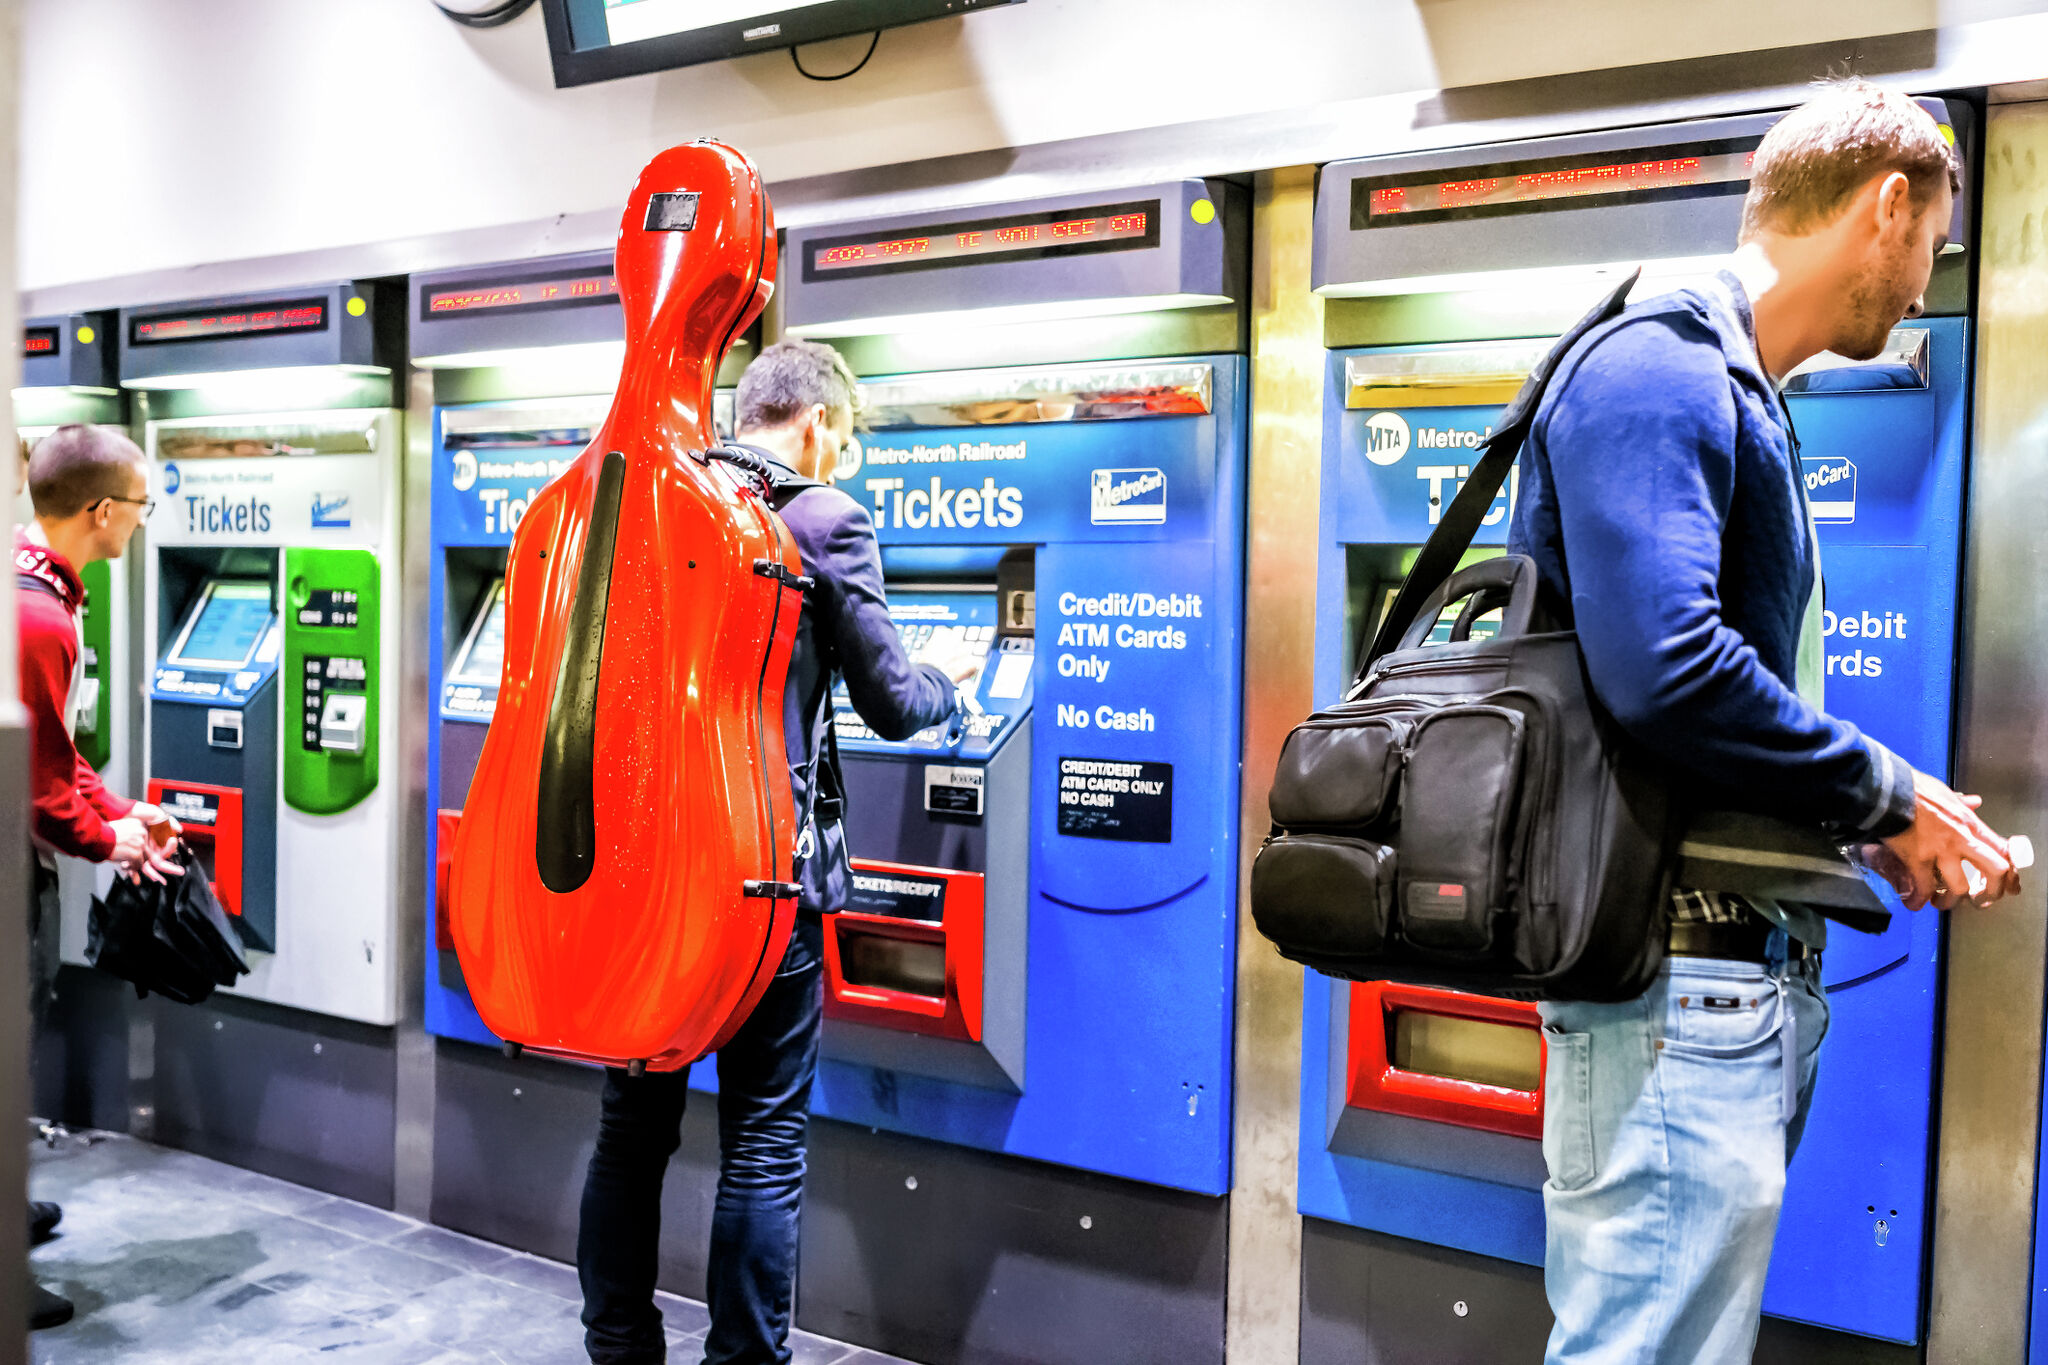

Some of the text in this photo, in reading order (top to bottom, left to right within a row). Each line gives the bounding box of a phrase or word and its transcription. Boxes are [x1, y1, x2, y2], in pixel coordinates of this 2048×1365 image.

[866, 444, 956, 465] Metro-North
[958, 441, 1026, 462] Railroad
[185, 496, 271, 532] Tickets
[865, 476, 1024, 529] Tickets
[1058, 592, 1202, 618] Credit/Debit
[1057, 623, 1187, 649] ATM Cards
[1057, 653, 1111, 683] Only
[1057, 704, 1155, 732] No Cash
[1061, 761, 1143, 778] CREDIT/DEBIT
[1061, 776, 1164, 795] ATM CARDS ONLY
[1061, 792, 1114, 807] NO CASH
